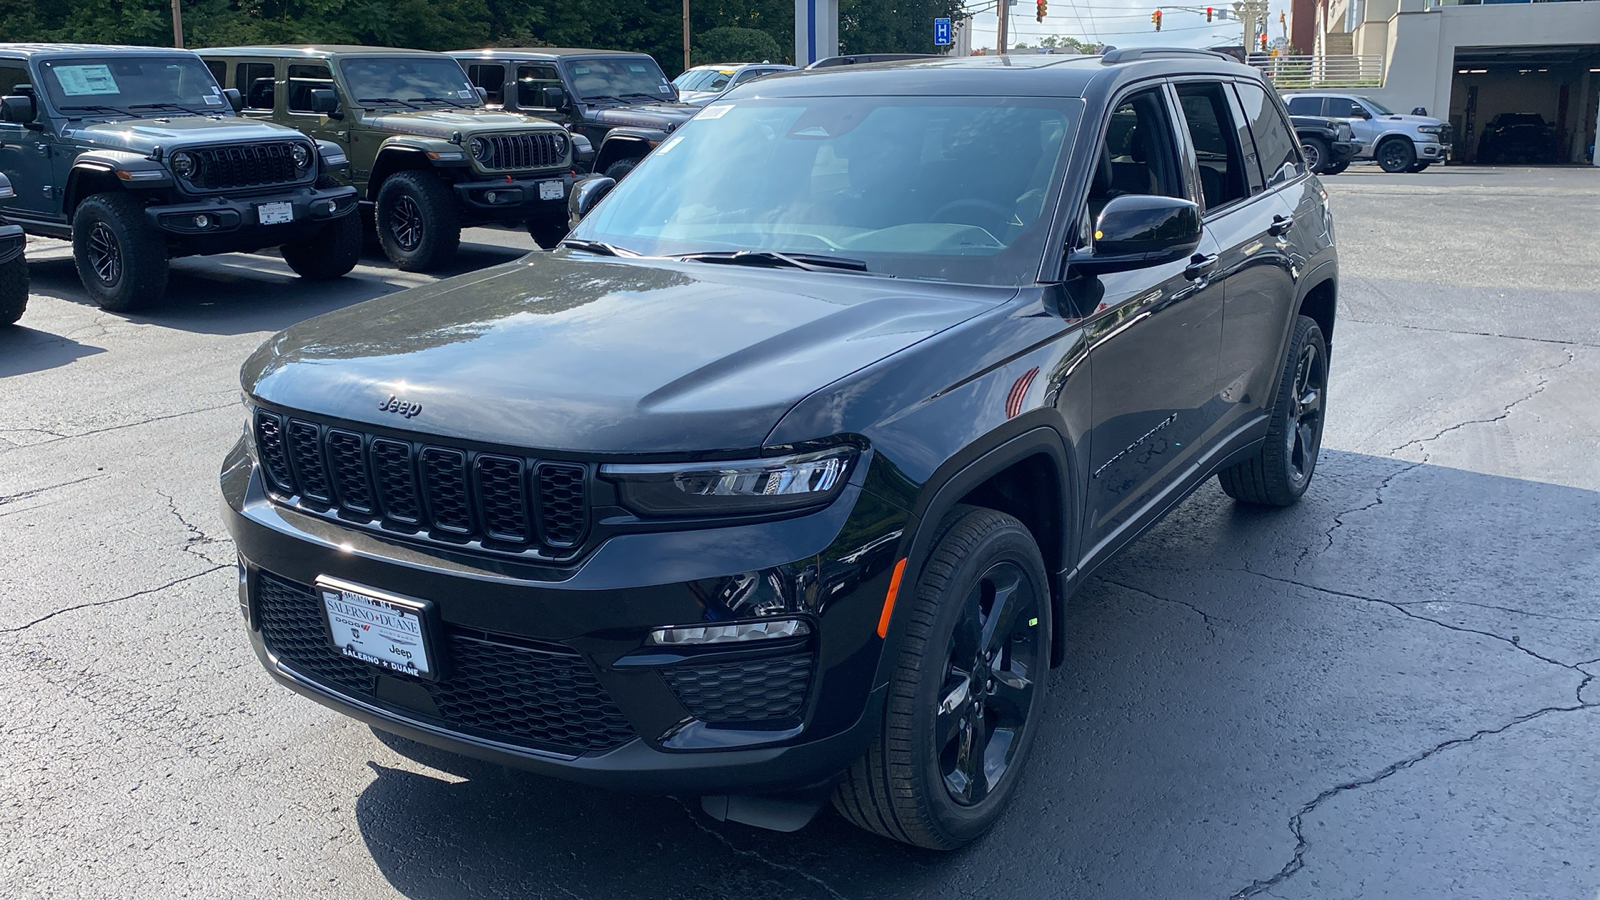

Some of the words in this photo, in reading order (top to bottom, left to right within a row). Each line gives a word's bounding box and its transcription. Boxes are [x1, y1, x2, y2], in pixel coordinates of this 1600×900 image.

[938, 24, 947, 37] H
[378, 394, 423, 419] Jeep
[327, 600, 375, 622] SALERNO
[380, 613, 419, 635] DUANE
[342, 647, 380, 665] SALERNO
[391, 662, 420, 677] DUANE
[389, 644, 413, 660] Jeep
